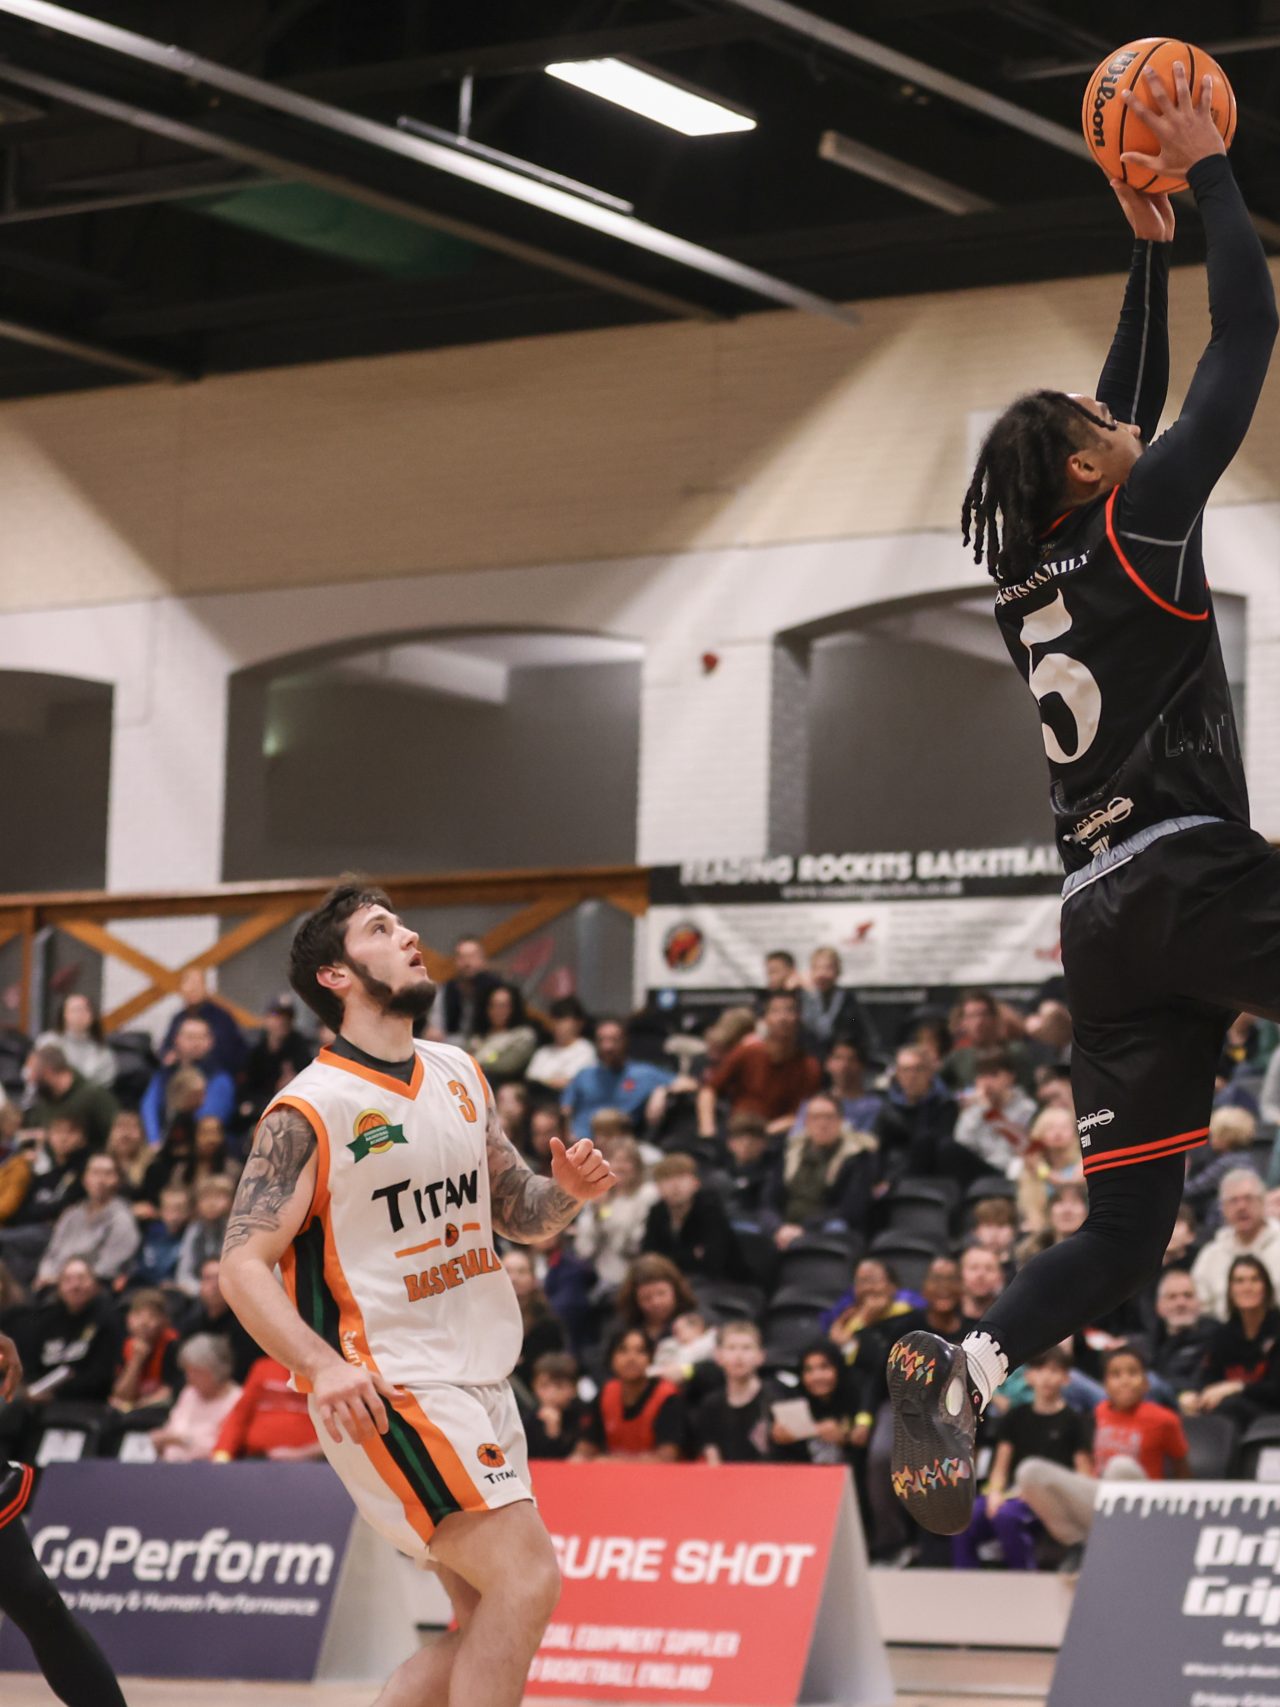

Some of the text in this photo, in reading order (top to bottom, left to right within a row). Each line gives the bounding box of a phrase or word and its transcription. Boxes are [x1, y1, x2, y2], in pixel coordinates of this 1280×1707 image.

[1092, 51, 1140, 147] Wilson
[1019, 587, 1102, 764] 5
[797, 850, 913, 882] ROCKETS
[915, 844, 1066, 878] BASKETBAL
[447, 1080, 477, 1123] 3
[31, 1525, 335, 1586] GoPerform
[550, 1533, 817, 1588] SURE SHOT
[204, 1592, 319, 1616] Performance
